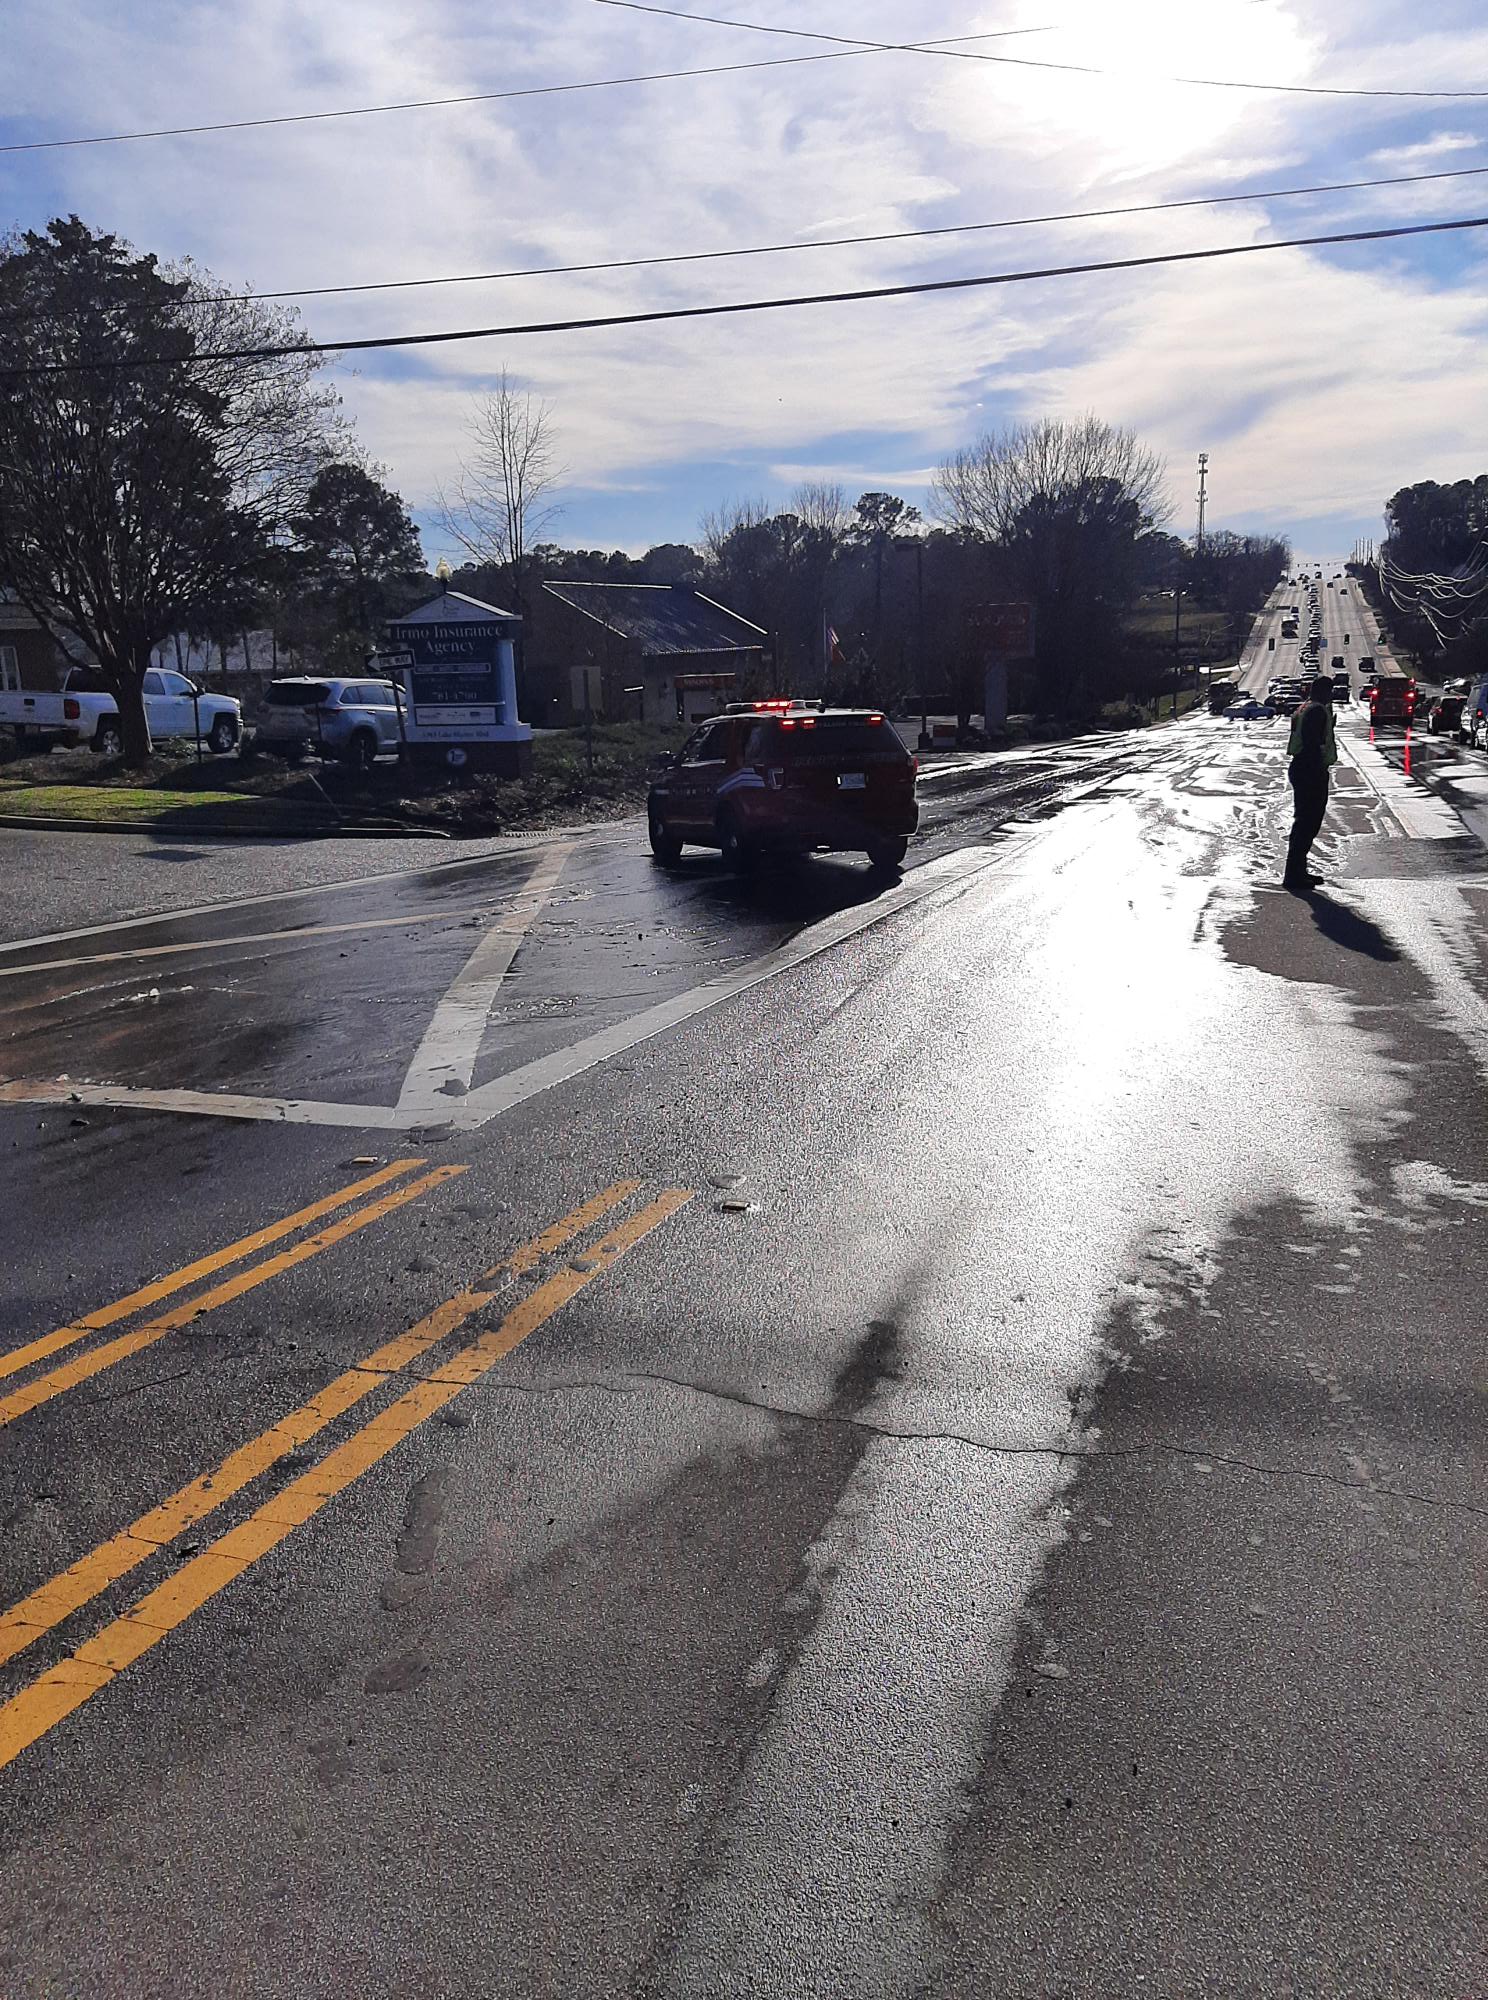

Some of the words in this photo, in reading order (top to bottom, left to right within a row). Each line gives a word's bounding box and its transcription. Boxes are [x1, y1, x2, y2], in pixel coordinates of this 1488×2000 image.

[396, 626, 429, 640] Irmo
[434, 624, 503, 639] Insurance
[425, 640, 476, 656] Agency
